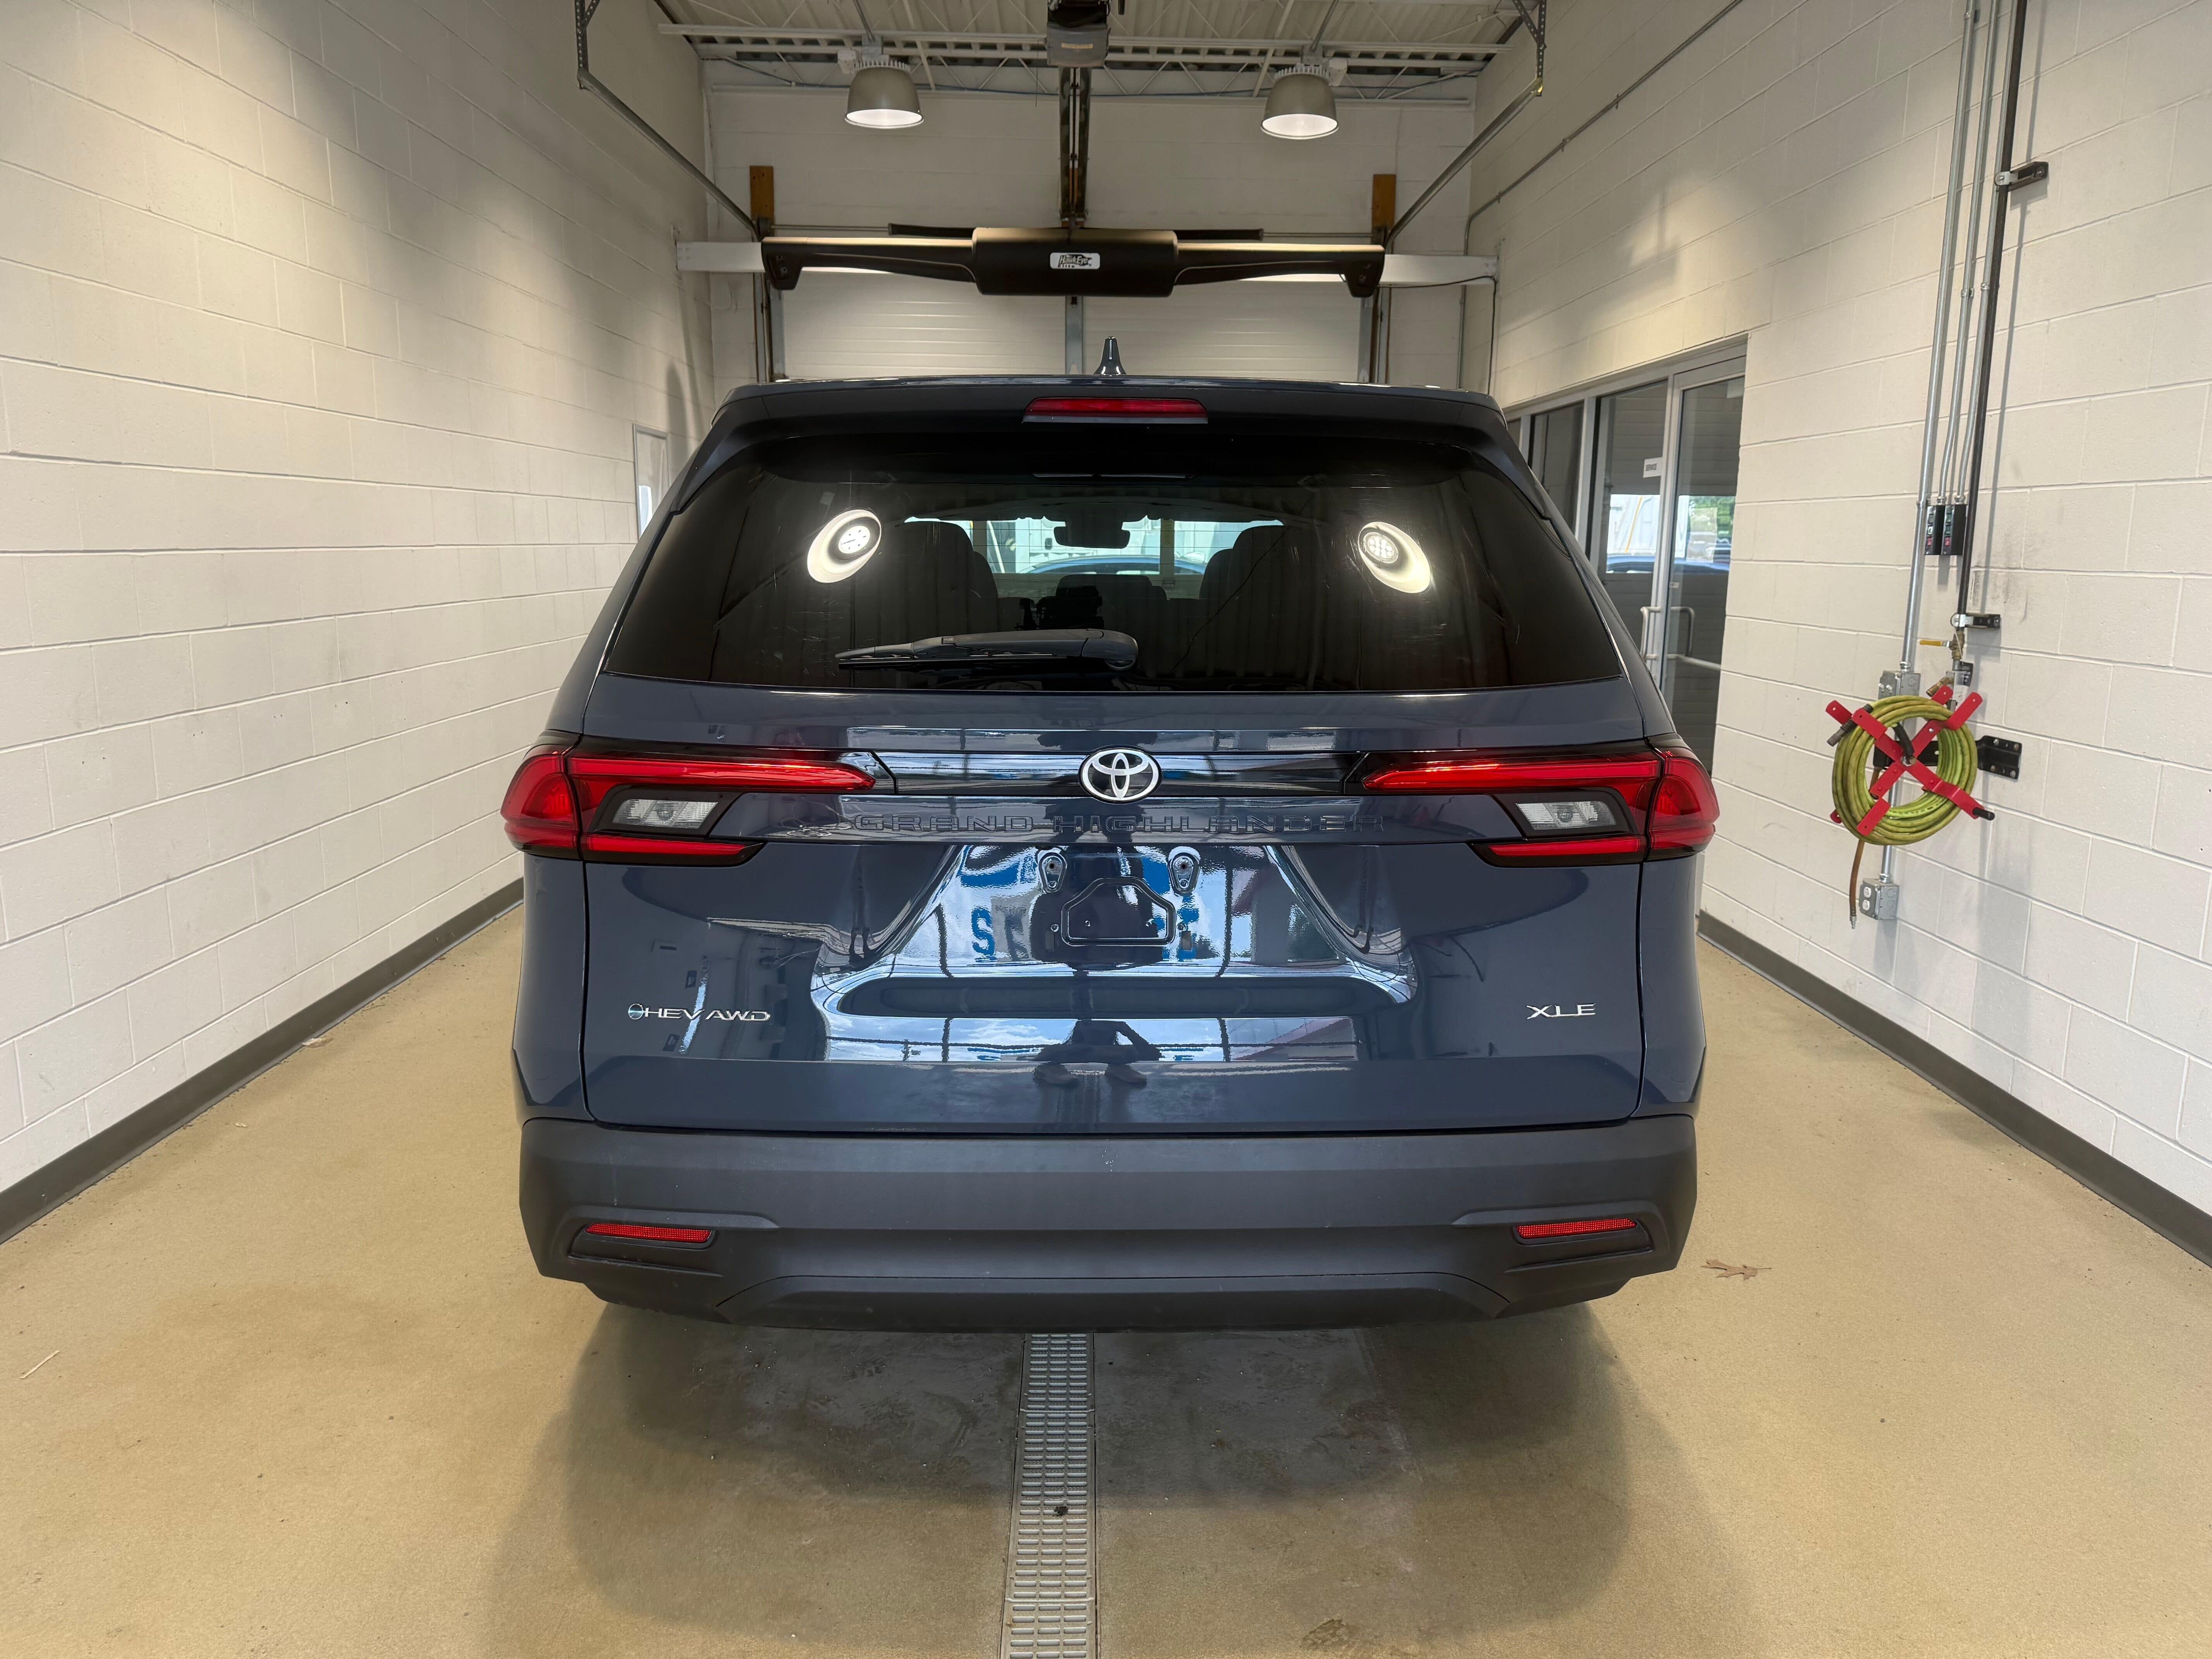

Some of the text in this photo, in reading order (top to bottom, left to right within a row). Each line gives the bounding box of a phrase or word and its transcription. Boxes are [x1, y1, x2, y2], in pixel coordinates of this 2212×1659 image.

[1059, 254, 1089, 265] HawkEye
[854, 814, 1384, 833] GRAND HIGHLANDER
[644, 1008, 771, 1022] HEV AWD
[1526, 1003, 1596, 1020] XLE
